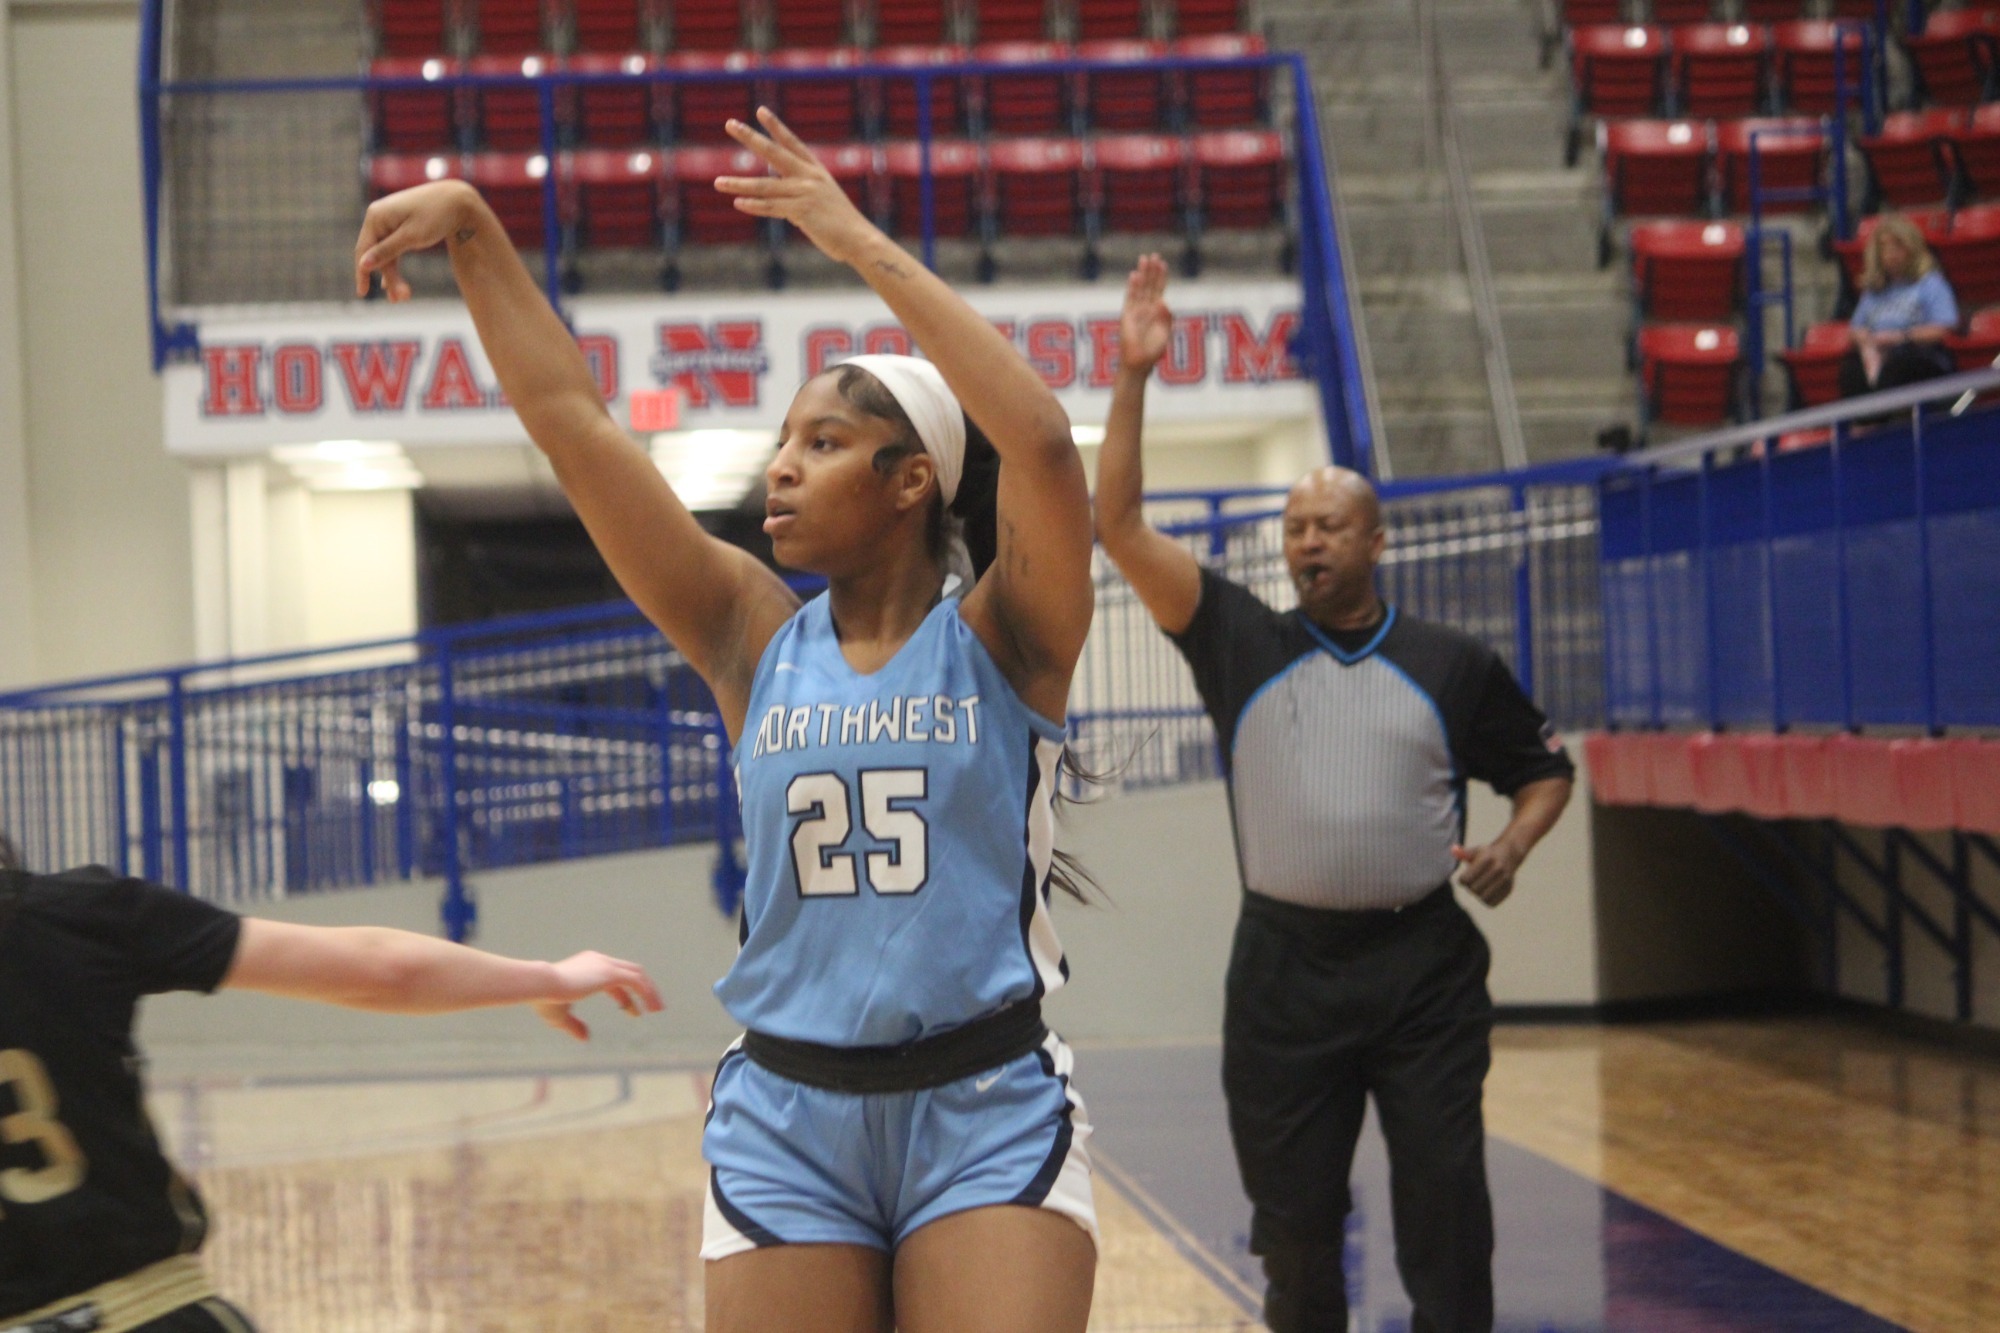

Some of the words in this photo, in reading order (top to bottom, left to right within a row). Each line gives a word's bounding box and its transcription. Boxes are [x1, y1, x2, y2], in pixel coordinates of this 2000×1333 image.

[202, 333, 622, 417] HOWAD
[752, 695, 979, 761] NORTHWEST
[785, 766, 929, 899] 25
